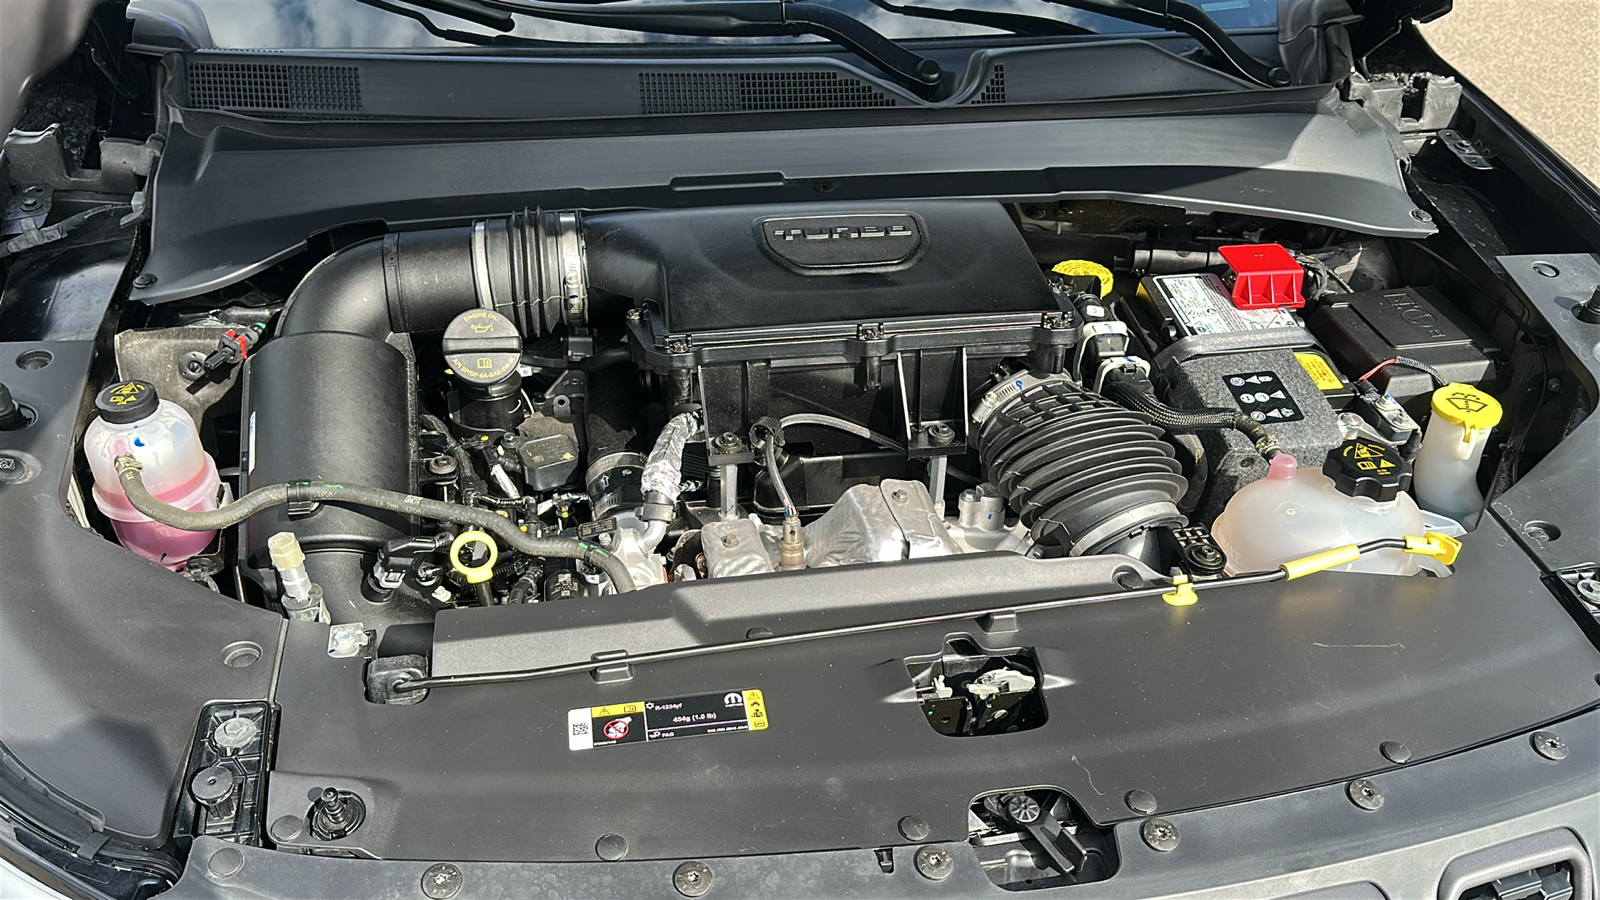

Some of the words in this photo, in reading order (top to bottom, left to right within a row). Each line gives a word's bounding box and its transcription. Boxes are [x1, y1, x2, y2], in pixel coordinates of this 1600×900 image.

[774, 225, 912, 241] TURBO
[463, 312, 487, 322] ENGINE
[488, 312, 499, 321] OIL
[654, 703, 682, 711] R-1234yf
[692, 714, 705, 722] (1.0
